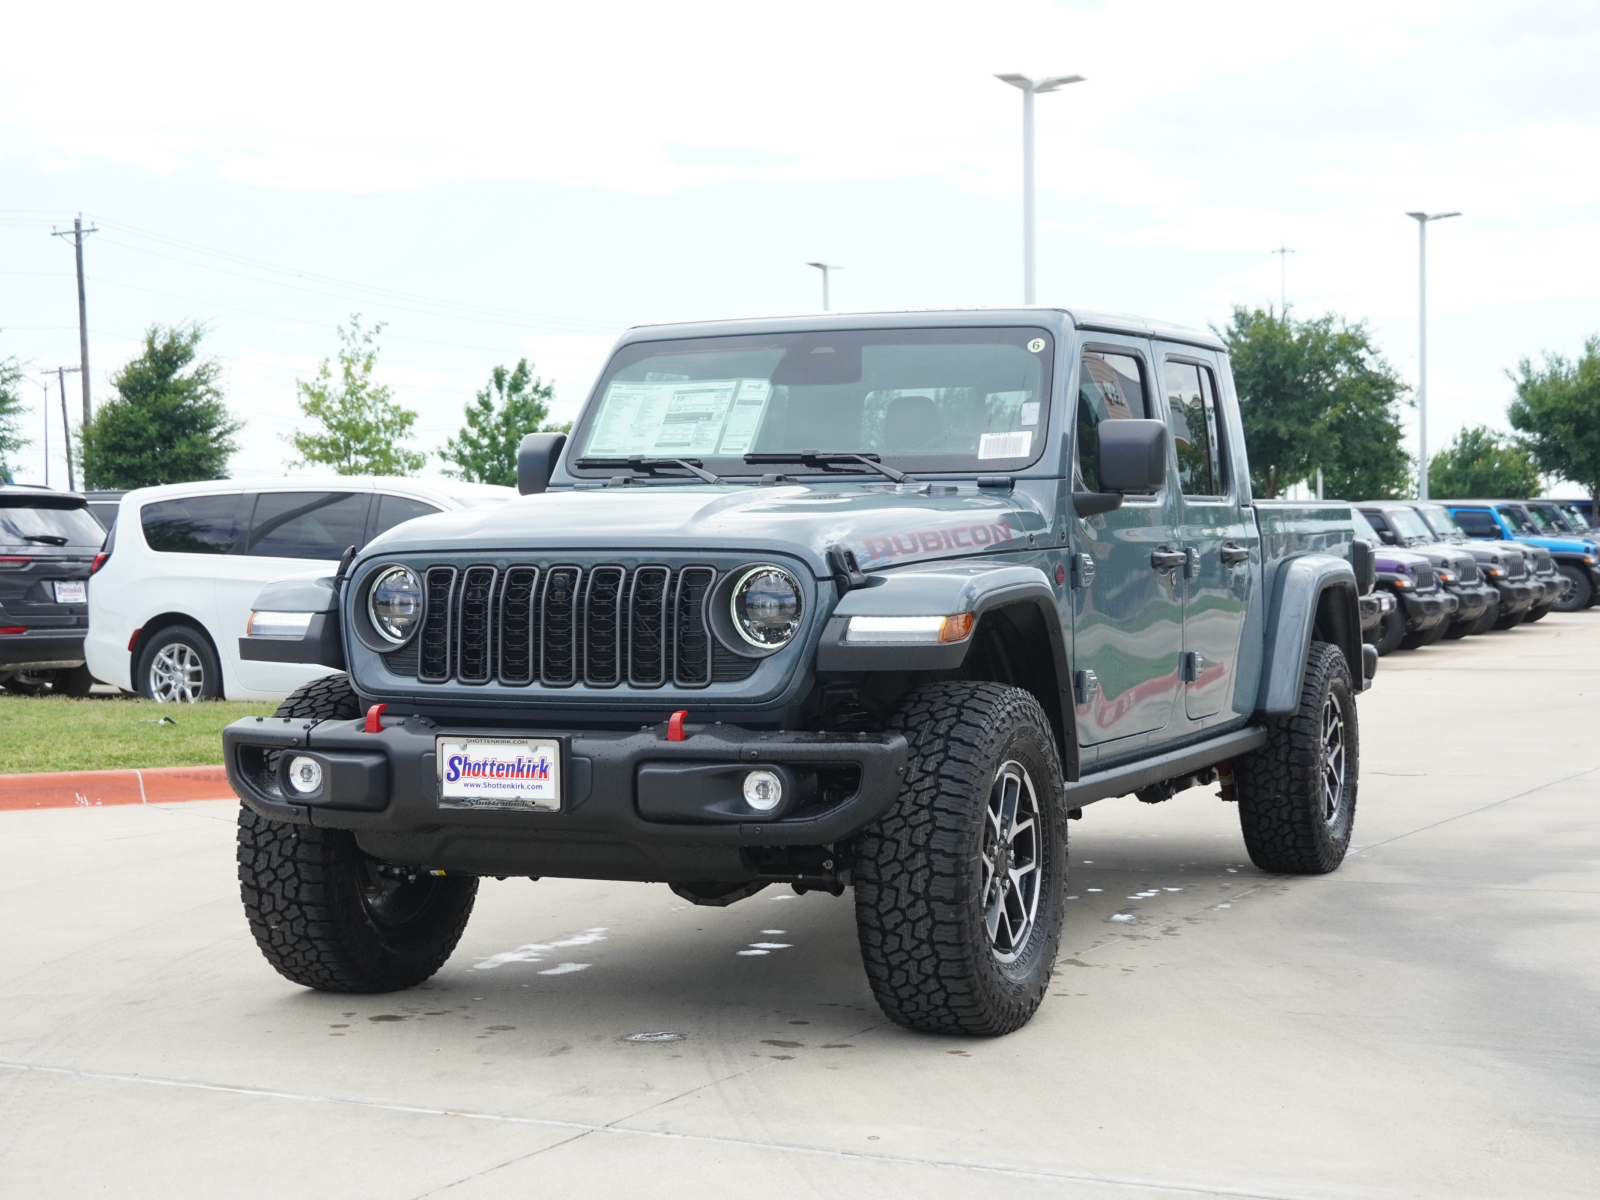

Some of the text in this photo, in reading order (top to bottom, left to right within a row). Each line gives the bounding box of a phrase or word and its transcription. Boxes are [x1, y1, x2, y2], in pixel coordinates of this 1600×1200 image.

[1032, 341, 1040, 350] 6
[862, 522, 1014, 560] RUBICON
[446, 755, 550, 782] Shottenkirk
[463, 782, 543, 790] www.Shottenkirk.com
